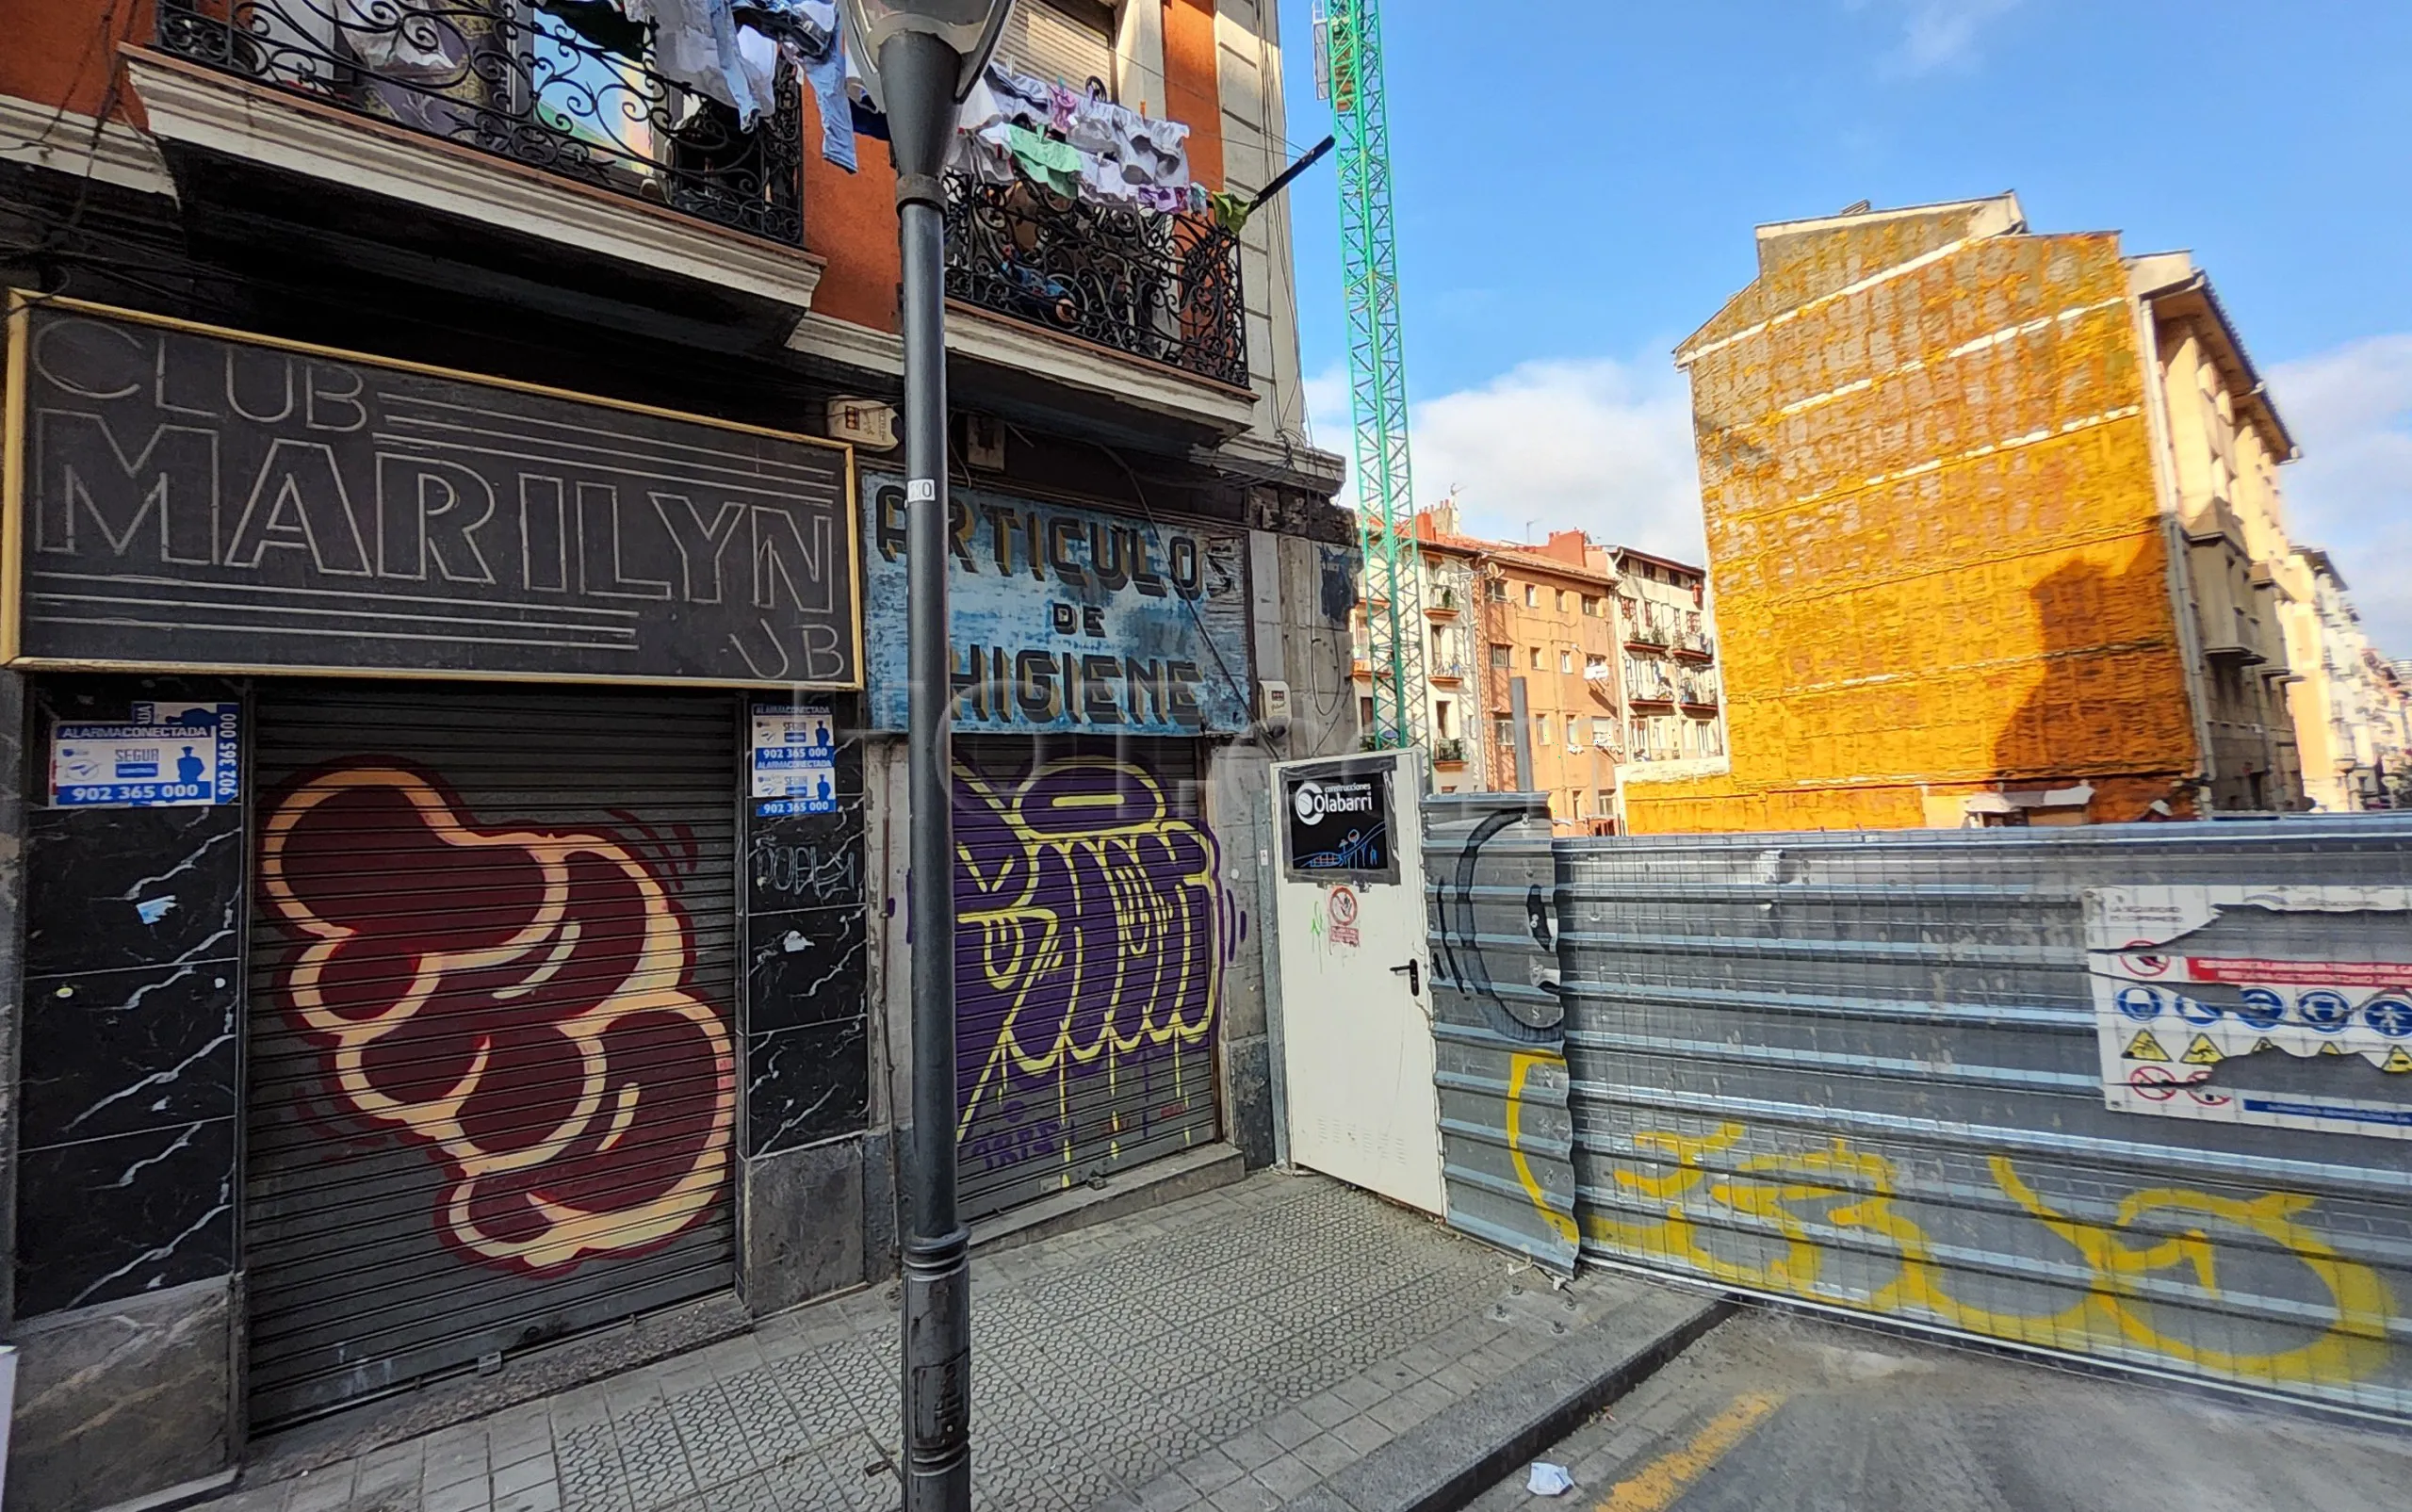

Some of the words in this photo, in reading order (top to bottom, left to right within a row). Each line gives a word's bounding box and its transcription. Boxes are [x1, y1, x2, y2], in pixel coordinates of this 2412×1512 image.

[33, 318, 368, 433] CLUB
[35, 407, 834, 615] MARILYN
[1052, 602, 1106, 637] DE
[61, 726, 208, 739] ALARMACONECTADA
[220, 713, 236, 738] 000
[114, 748, 159, 763] SEGUR
[219, 742, 237, 767] 365
[763, 749, 784, 759] 902
[787, 749, 807, 758] 365
[808, 747, 828, 757] 000
[72, 788, 112, 801] 902
[119, 786, 156, 799] 365
[161, 784, 199, 798] 000
[218, 770, 237, 796] 902
[1324, 783, 1372, 792] construcciones
[763, 804, 785, 814] 902
[787, 803, 807, 812] 365
[808, 802, 829, 811] 000
[1313, 793, 1373, 813] Olabarri
